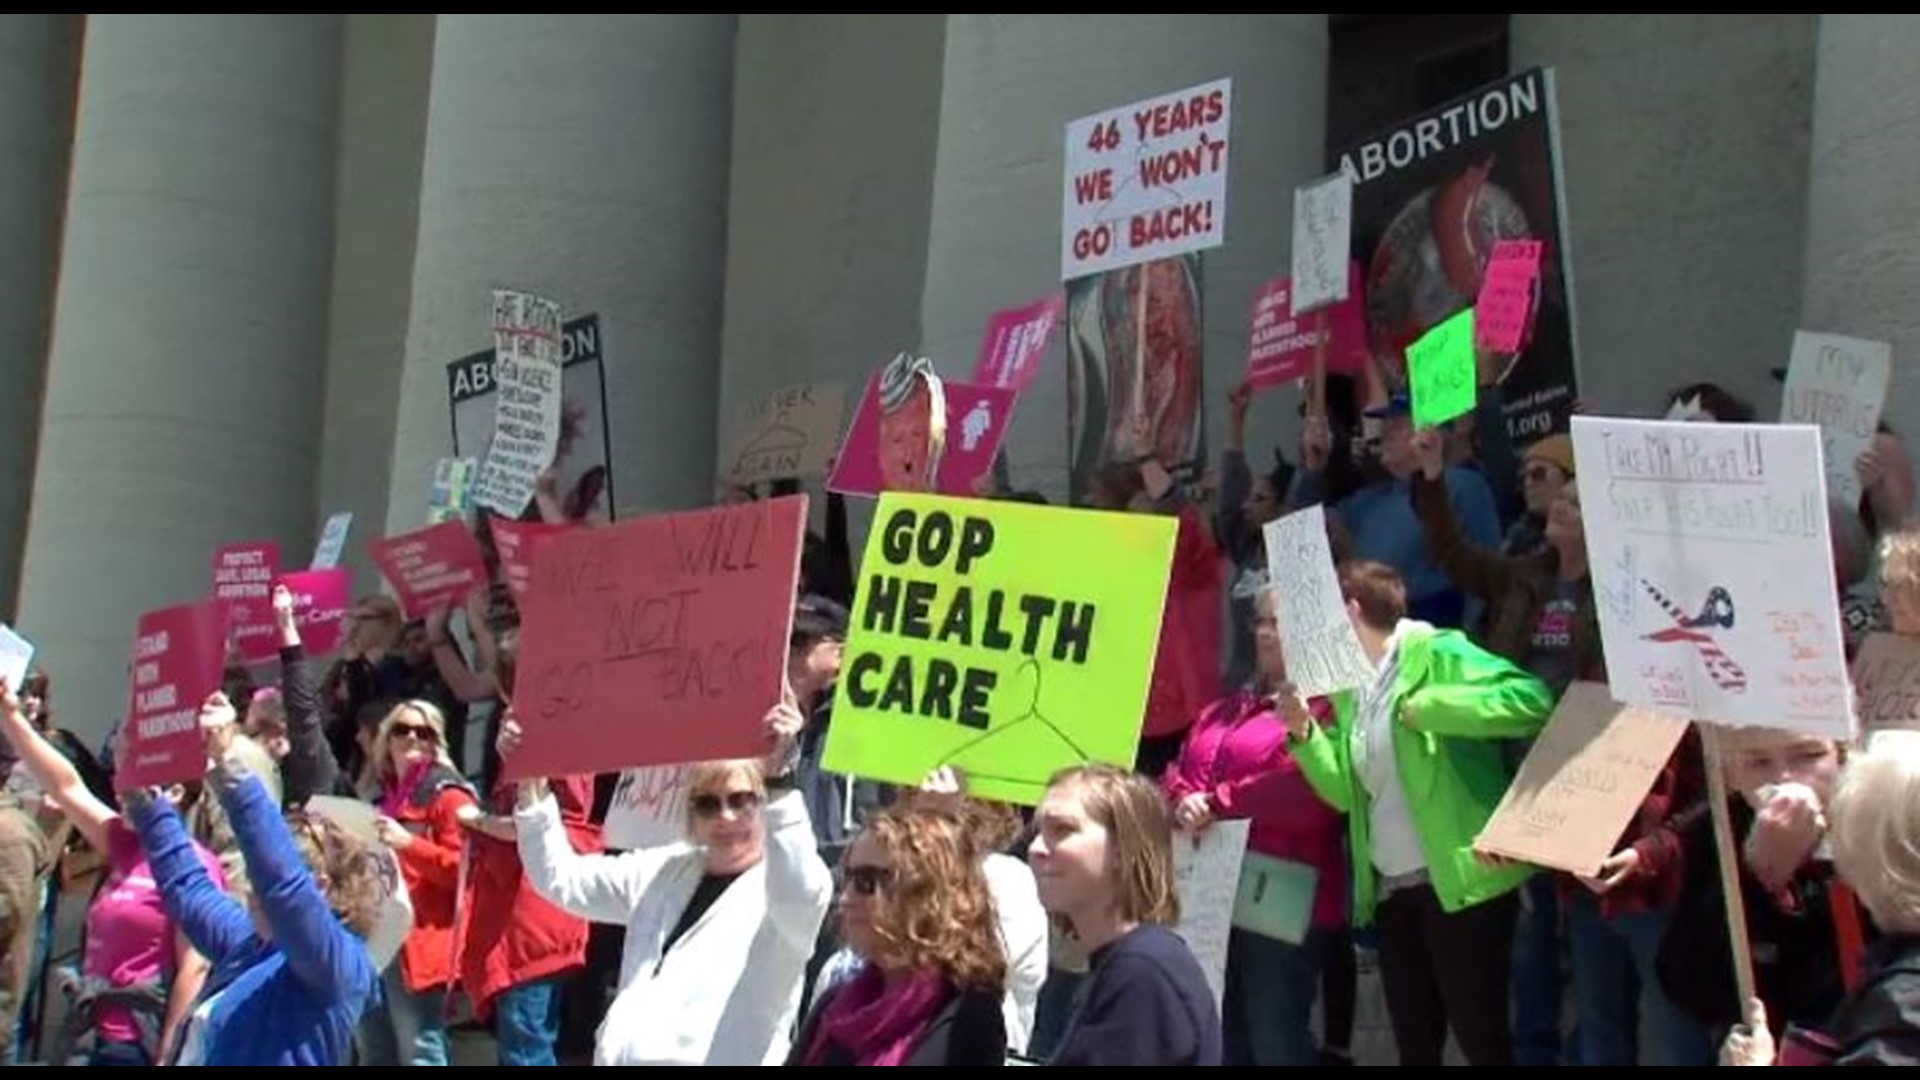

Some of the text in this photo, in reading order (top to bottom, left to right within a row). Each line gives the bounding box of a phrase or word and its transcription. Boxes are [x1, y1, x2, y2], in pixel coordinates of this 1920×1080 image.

[1087, 90, 1223, 153] 46 YEARS
[1339, 75, 1540, 185] ABORTION
[1074, 132, 1225, 204] WE WON'T
[1073, 200, 1213, 260] GO BACK!
[1815, 343, 1865, 386] MY
[550, 536, 622, 597] WE
[671, 514, 760, 577] WILL
[881, 508, 995, 574] GOP
[604, 588, 703, 652] NOT
[861, 574, 1096, 665] HEALTH
[846, 651, 998, 731] CARE
